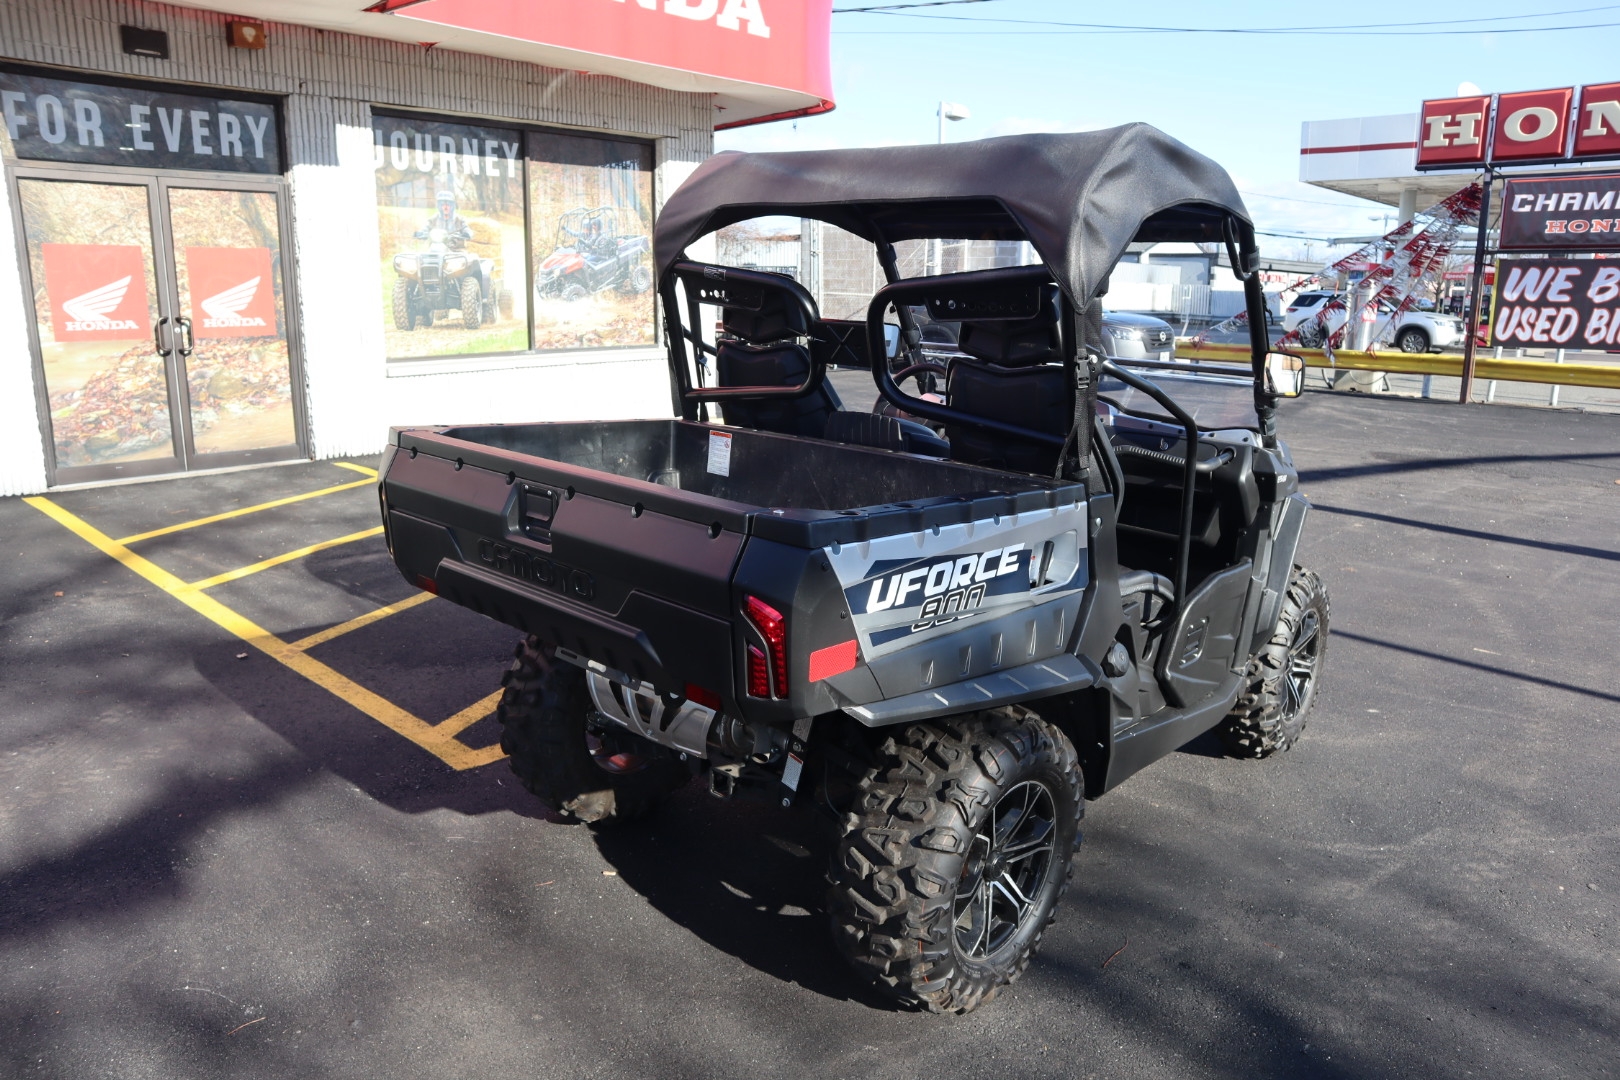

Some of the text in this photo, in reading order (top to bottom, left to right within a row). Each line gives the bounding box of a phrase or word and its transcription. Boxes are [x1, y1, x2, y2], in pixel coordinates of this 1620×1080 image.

[1, 90, 269, 158] FOR EVERY
[374, 129, 519, 178] JOURNEY
[1502, 266, 1582, 303] WE
[65, 319, 139, 331] HONDA
[203, 317, 267, 328] HONDA
[1494, 305, 1620, 344] USED BI
[866, 543, 1025, 614] UFORCE
